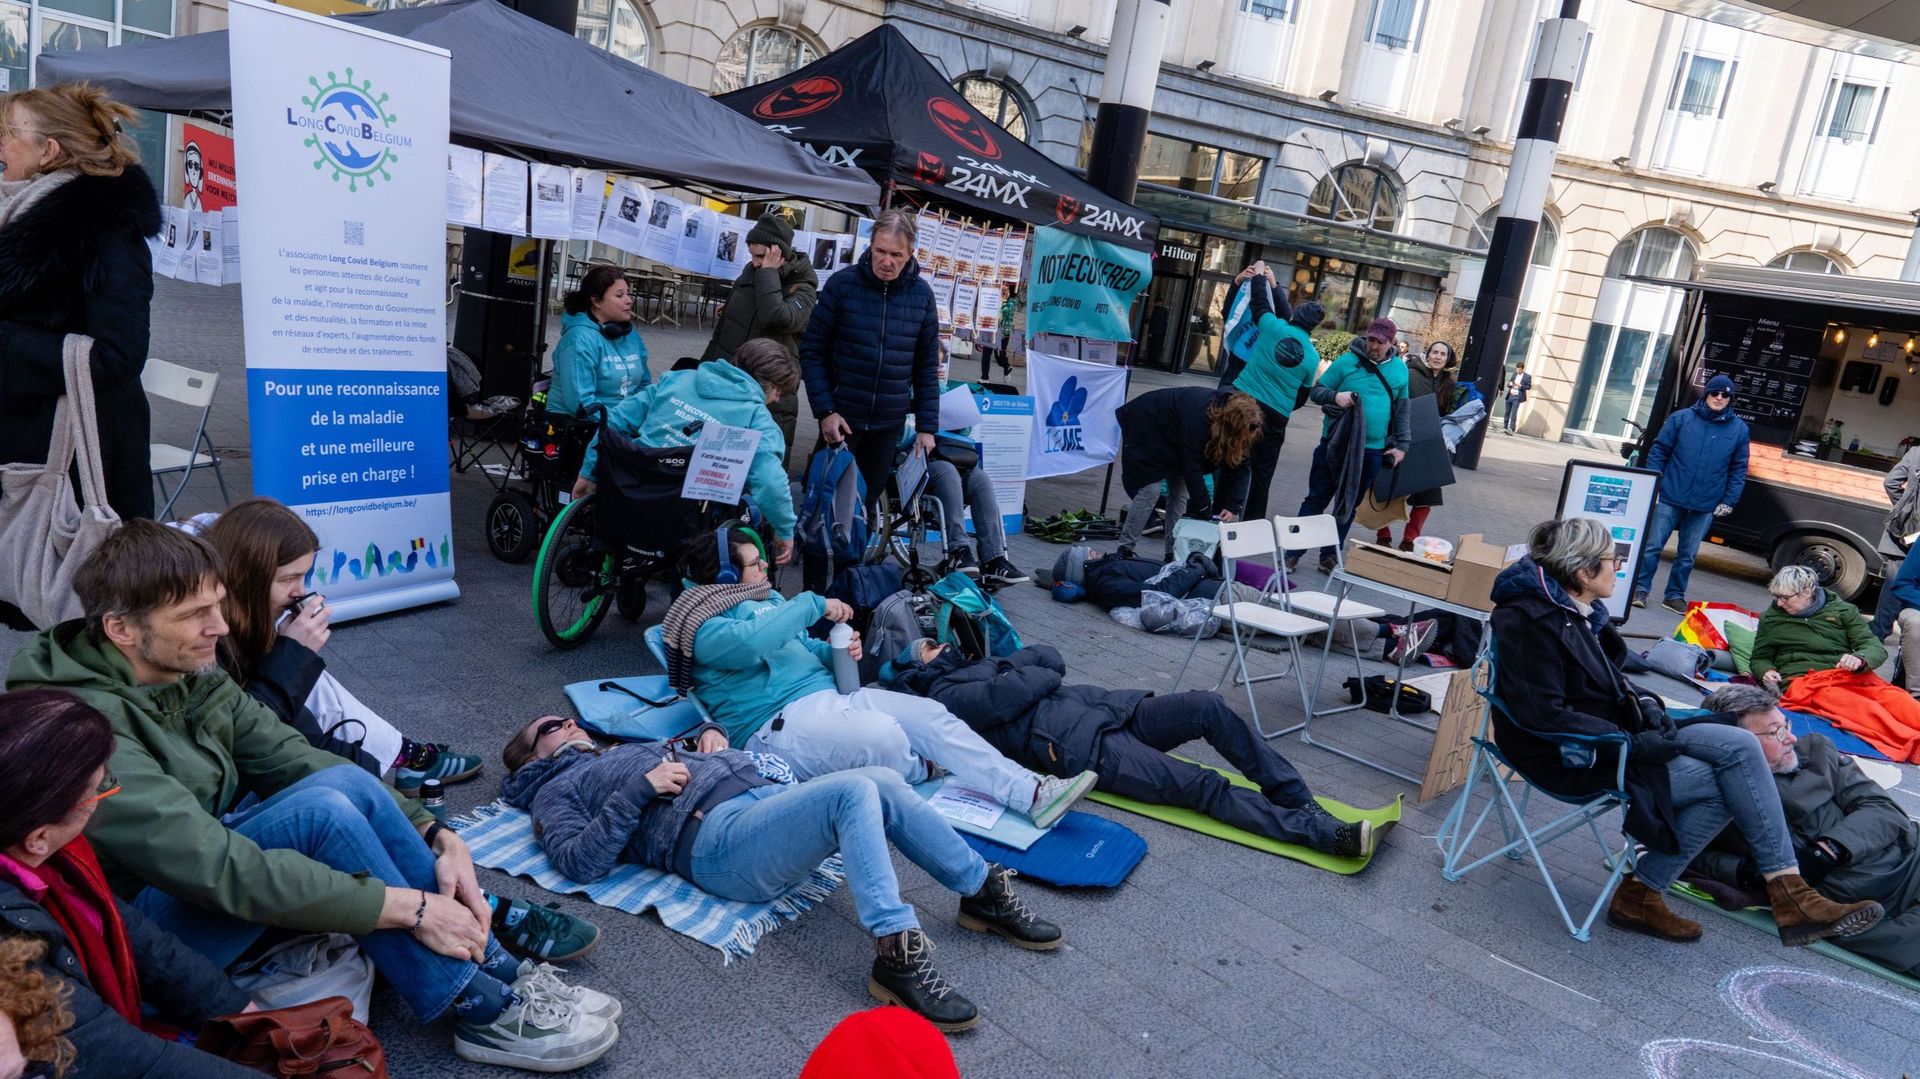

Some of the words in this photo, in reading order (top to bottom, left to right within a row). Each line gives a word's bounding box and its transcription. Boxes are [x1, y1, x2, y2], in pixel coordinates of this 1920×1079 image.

[944, 166, 1032, 209] 24MX
[1080, 203, 1147, 241] 24MX
[278, 249, 328, 261] L'association
[329, 254, 346, 265] Long
[347, 256, 368, 265] Covid
[369, 258, 399, 269] Belgium
[400, 262, 428, 272] soutient
[1161, 244, 1197, 262] Hilton
[289, 265, 301, 275] les
[302, 267, 340, 278] personnes
[341, 271, 373, 281] atteintes
[373, 273, 383, 282] de
[384, 274, 404, 284] Covid
[405, 275, 421, 287] long
[1037, 253, 1066, 285] NOT
[304, 283, 313, 292] et
[314, 283, 328, 295] agit
[328, 286, 346, 295] pour
[346, 286, 354, 295] la
[355, 288, 409, 299] reconnaissance
[271, 296, 283, 305] de
[284, 296, 292, 306] la
[293, 297, 326, 309] maladie,
[326, 300, 374, 311] l'intervention
[375, 303, 385, 312] du
[385, 303, 436, 315] Gouvernement
[284, 313, 293, 322] et
[294, 313, 309, 322] des
[350, 316, 357, 325] la
[358, 316, 394, 327] formation
[395, 318, 403, 327] et
[403, 318, 411, 328] la
[411, 320, 428, 329] mise
[1758, 318, 1780, 327] Menu
[272, 328, 283, 337] en
[285, 328, 315, 339] réseaux
[351, 331, 405, 342] l'augmentation
[406, 334, 419, 343] des
[419, 333, 438, 344] fonds
[302, 344, 312, 354] de
[313, 344, 348, 355] recherche
[349, 346, 357, 355] et
[358, 346, 371, 356] des
[264, 381, 302, 397] Pour
[306, 383, 333, 396] une
[337, 381, 440, 396] reconnaissance
[670, 397, 685, 407] NOT
[311, 411, 329, 426] de
[332, 410, 345, 426] la
[349, 409, 404, 425] maladie
[301, 443, 316, 457] et
[320, 442, 347, 456] une
[350, 438, 415, 454] meilleure
[302, 470, 337, 490] prise
[341, 471, 358, 484] en
[362, 465, 407, 484] charge
[410, 465, 416, 479] !
[305, 498, 417, 518] https://longcovidbelgium.be/
